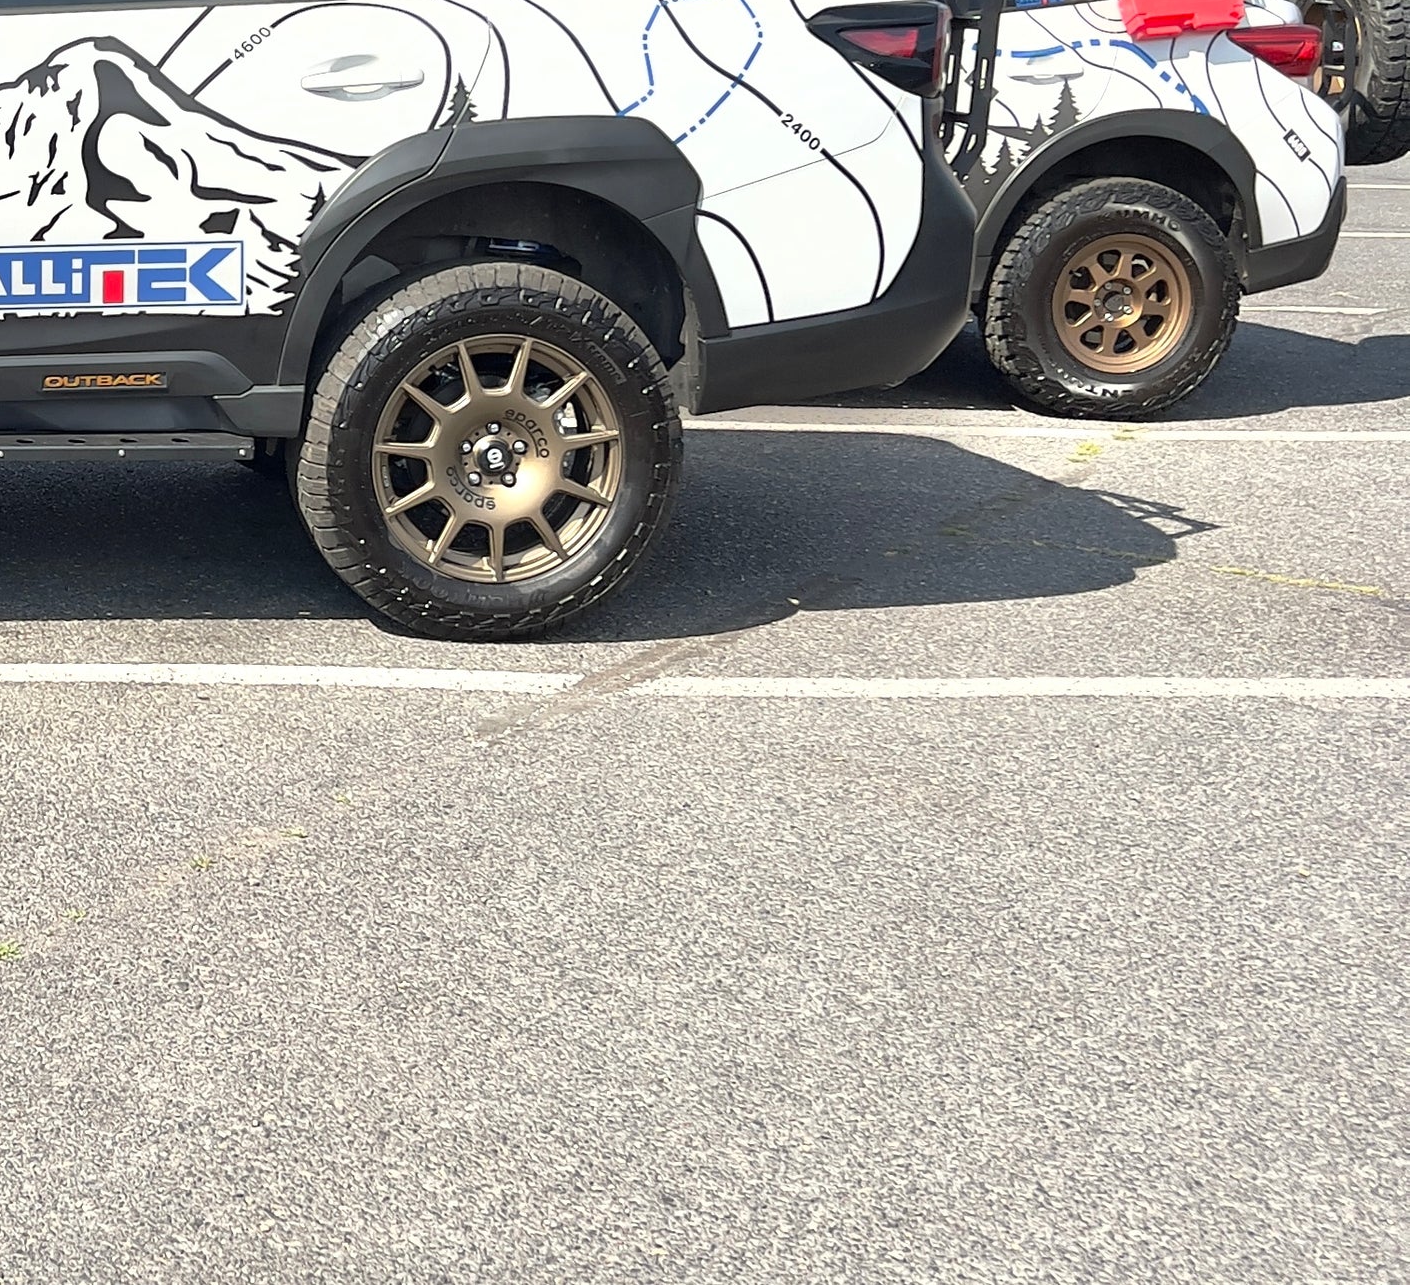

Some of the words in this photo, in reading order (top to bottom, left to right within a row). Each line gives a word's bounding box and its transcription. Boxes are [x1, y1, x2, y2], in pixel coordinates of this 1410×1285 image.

[234, 27, 271, 60] 4600
[780, 113, 821, 150] 2400
[44, 374, 162, 388] OUTBACK
[505, 409, 550, 458] sparco
[446, 466, 496, 510] sparco
